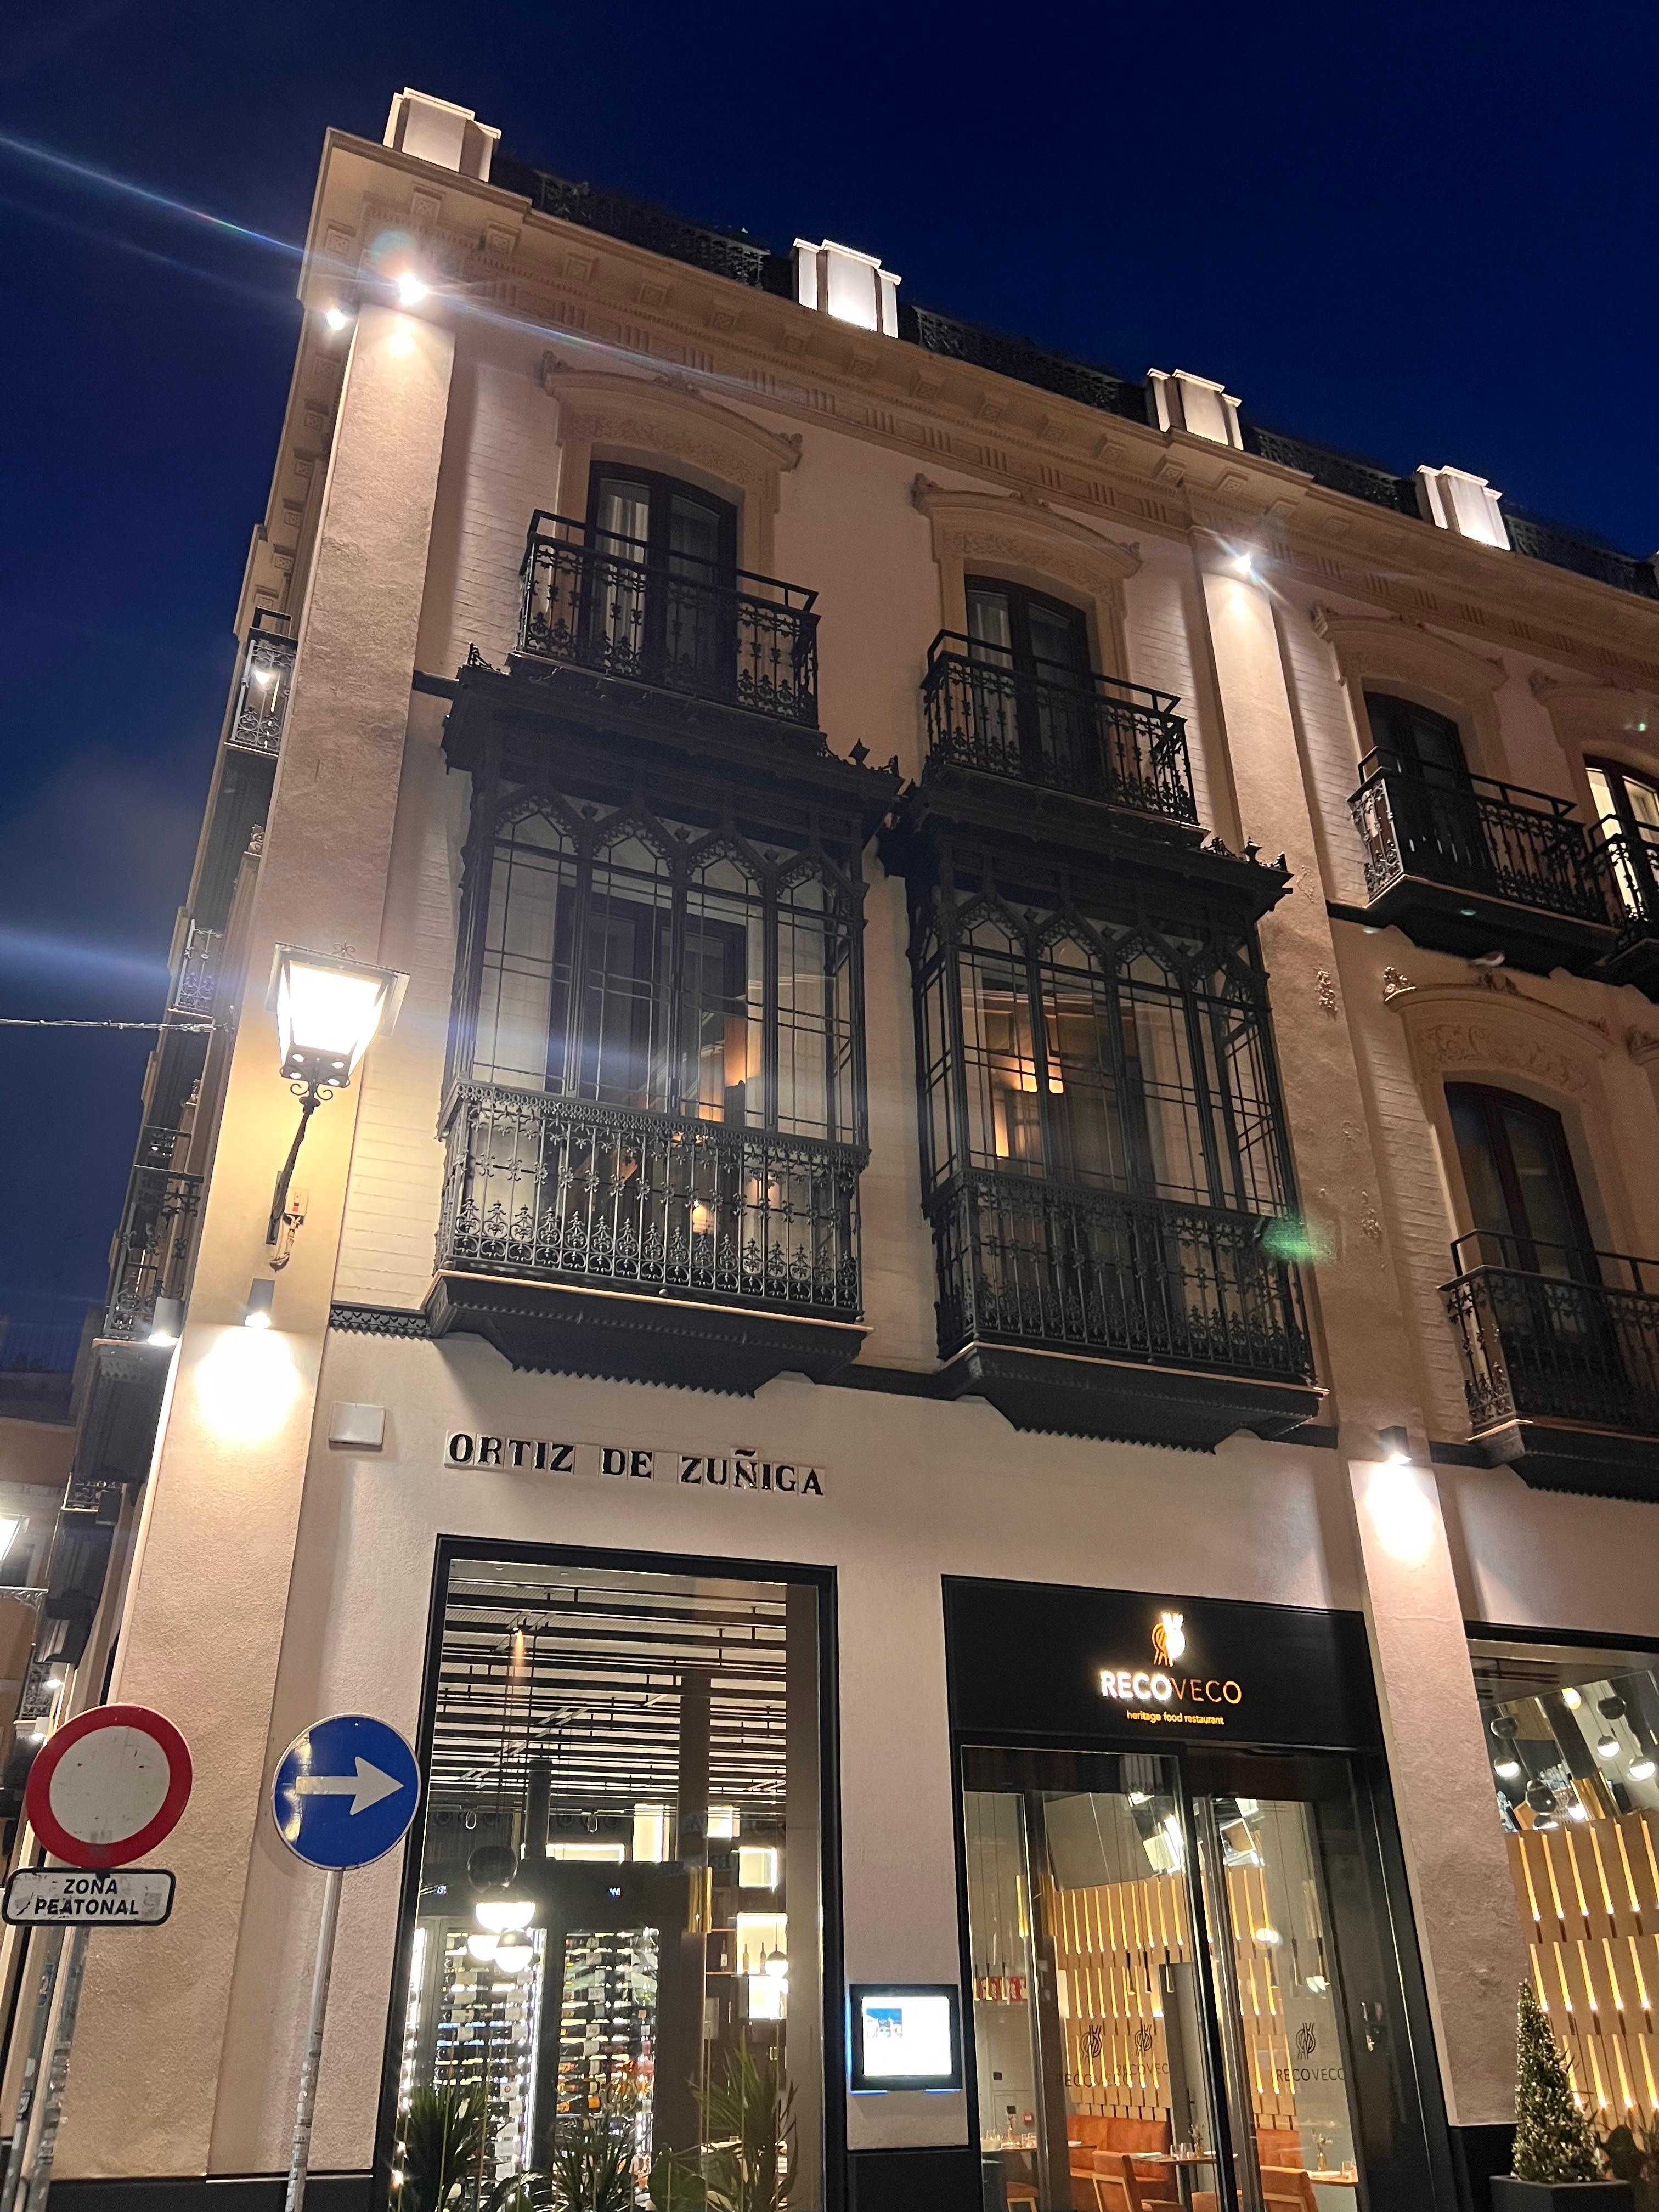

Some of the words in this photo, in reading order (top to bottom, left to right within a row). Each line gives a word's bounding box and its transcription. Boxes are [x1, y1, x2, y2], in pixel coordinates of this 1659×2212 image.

[449, 1434, 574, 1472] ORTIZ
[602, 1448, 652, 1479] DE
[680, 1449, 823, 1496] ZUÑIGA
[1099, 1670, 1242, 1704] RECOVECO
[1126, 1710, 1161, 1723] heritage
[1163, 1711, 1183, 1722] food
[1184, 1715, 1224, 1725] restaurant
[63, 1878, 117, 1894] ZONA
[34, 1897, 139, 1915] PEATONAL
[1116, 2063, 1170, 2075] RECOVEC
